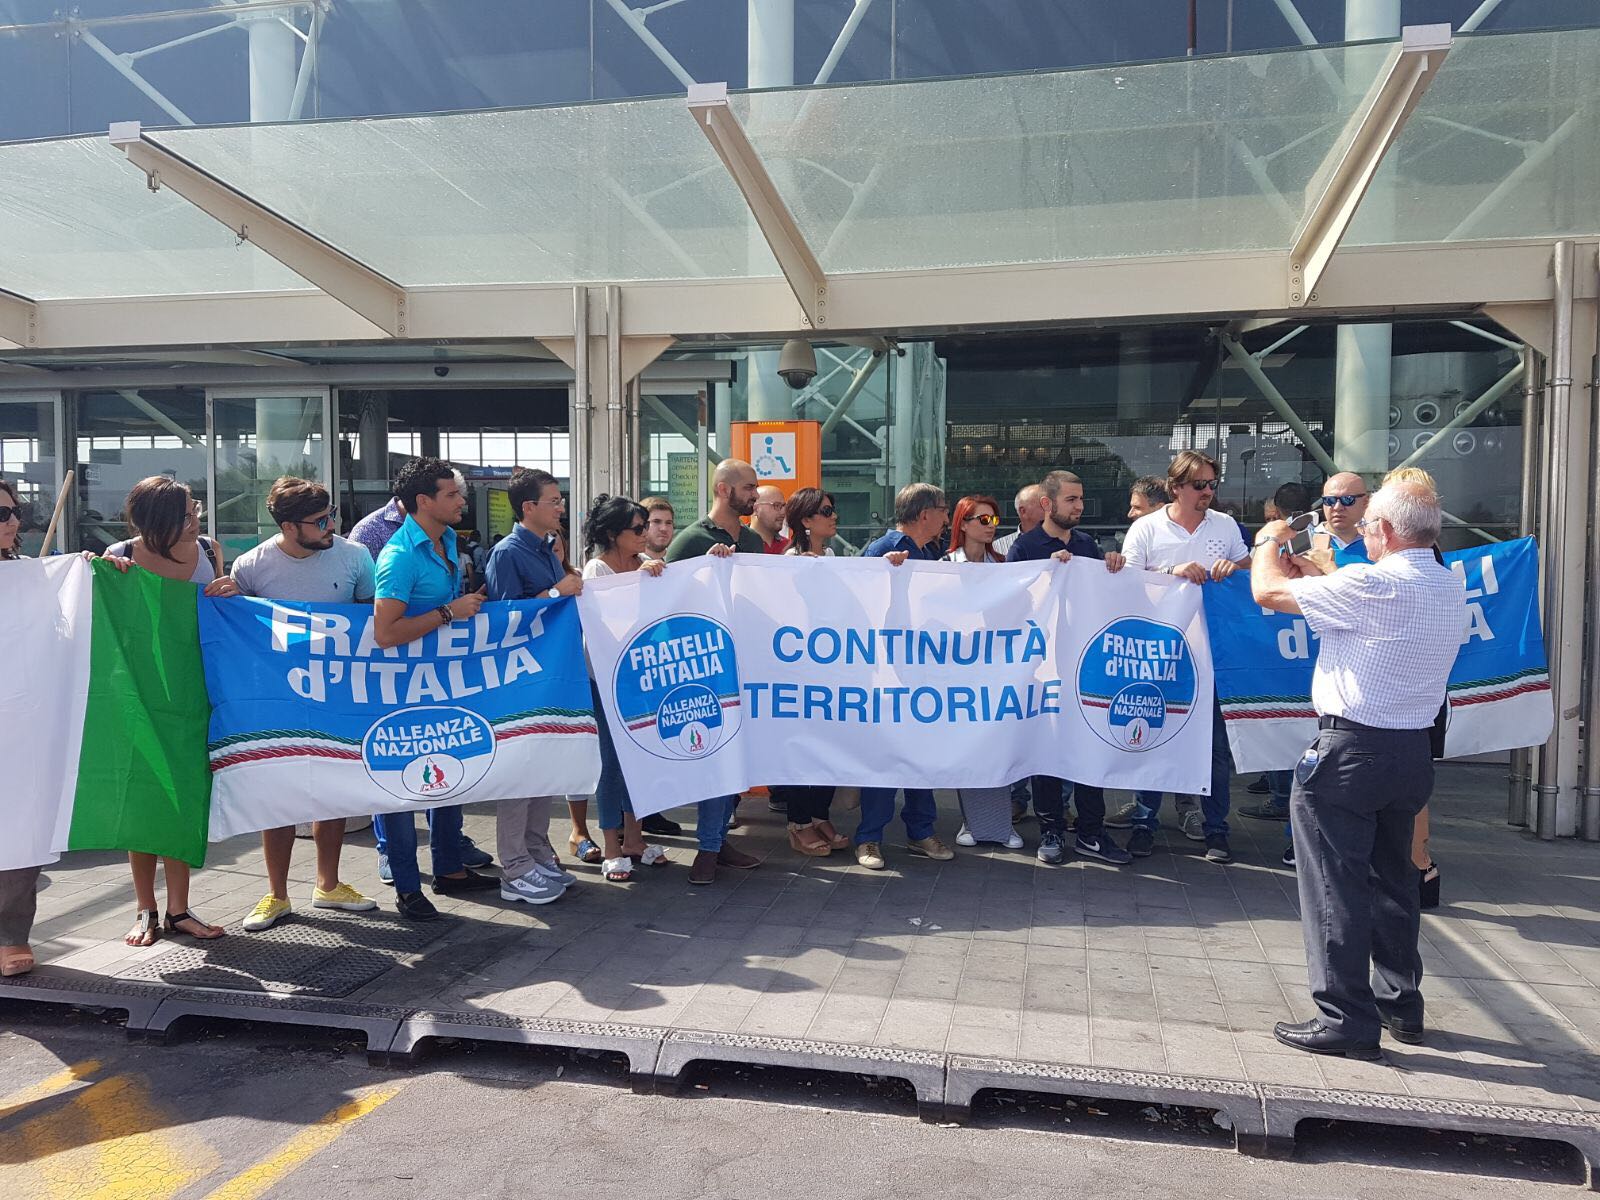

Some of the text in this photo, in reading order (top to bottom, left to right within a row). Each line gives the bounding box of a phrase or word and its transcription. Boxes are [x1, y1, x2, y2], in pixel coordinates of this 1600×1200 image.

[629, 628, 725, 671] FRATELLI
[772, 620, 1047, 665] CONTINUITÀ
[1102, 632, 1186, 661] FRATELLI
[287, 647, 543, 705] d'ITALIA
[639, 653, 724, 692] d'ITALIA
[1105, 659, 1177, 682] d'ITALIA
[662, 694, 715, 717] ALLEANZA
[743, 680, 1062, 723] TERRITORIALE
[1114, 704, 1163, 718] NAZIONALE
[1117, 693, 1162, 707] ALLEANZA
[375, 715, 476, 742] ALLEANZA
[661, 704, 718, 728] NAZIONALE
[372, 726, 483, 757] NAZIONALE
